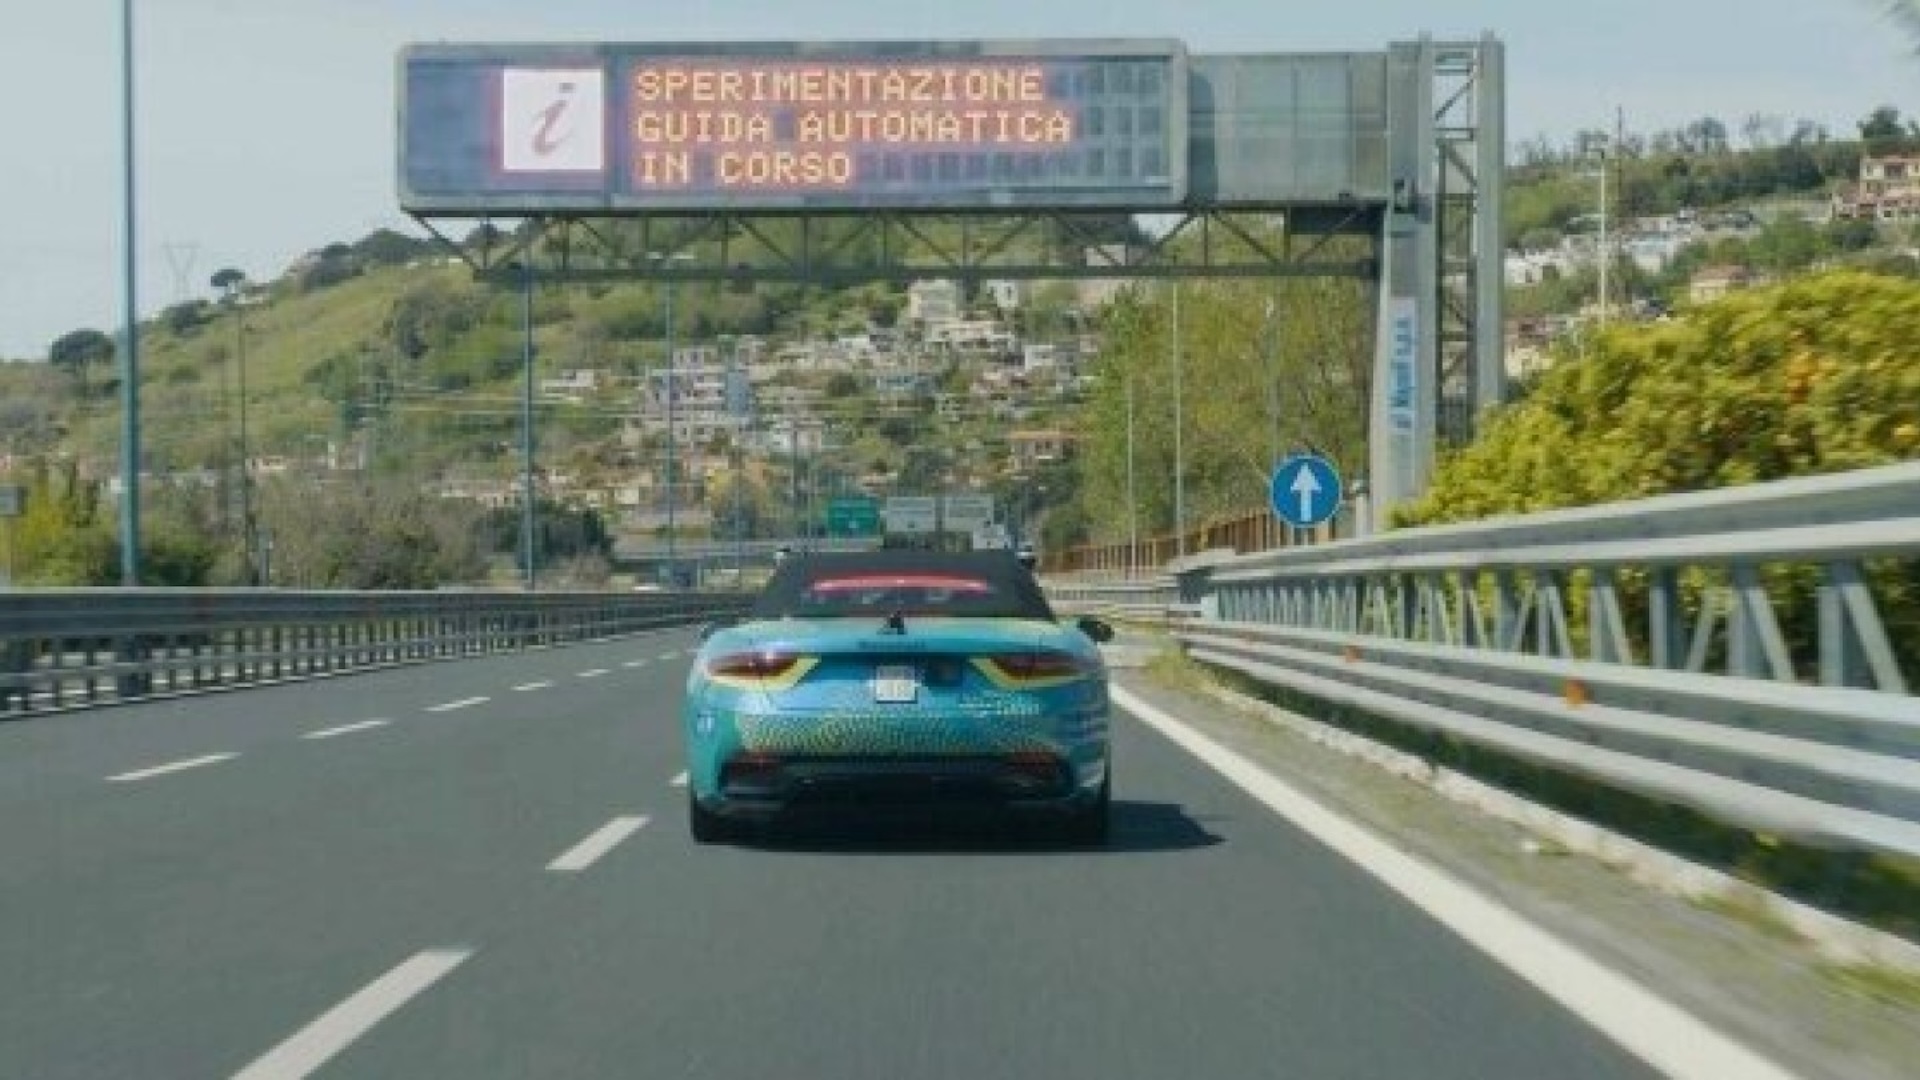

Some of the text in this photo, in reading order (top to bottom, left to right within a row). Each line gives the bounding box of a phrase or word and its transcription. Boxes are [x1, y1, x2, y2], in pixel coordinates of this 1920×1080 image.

[637, 70, 1043, 101] SPERIMENTAZIONE
[637, 110, 1070, 142] GUIDA AUTOMATICA
[643, 151, 850, 184] IN CORSO
